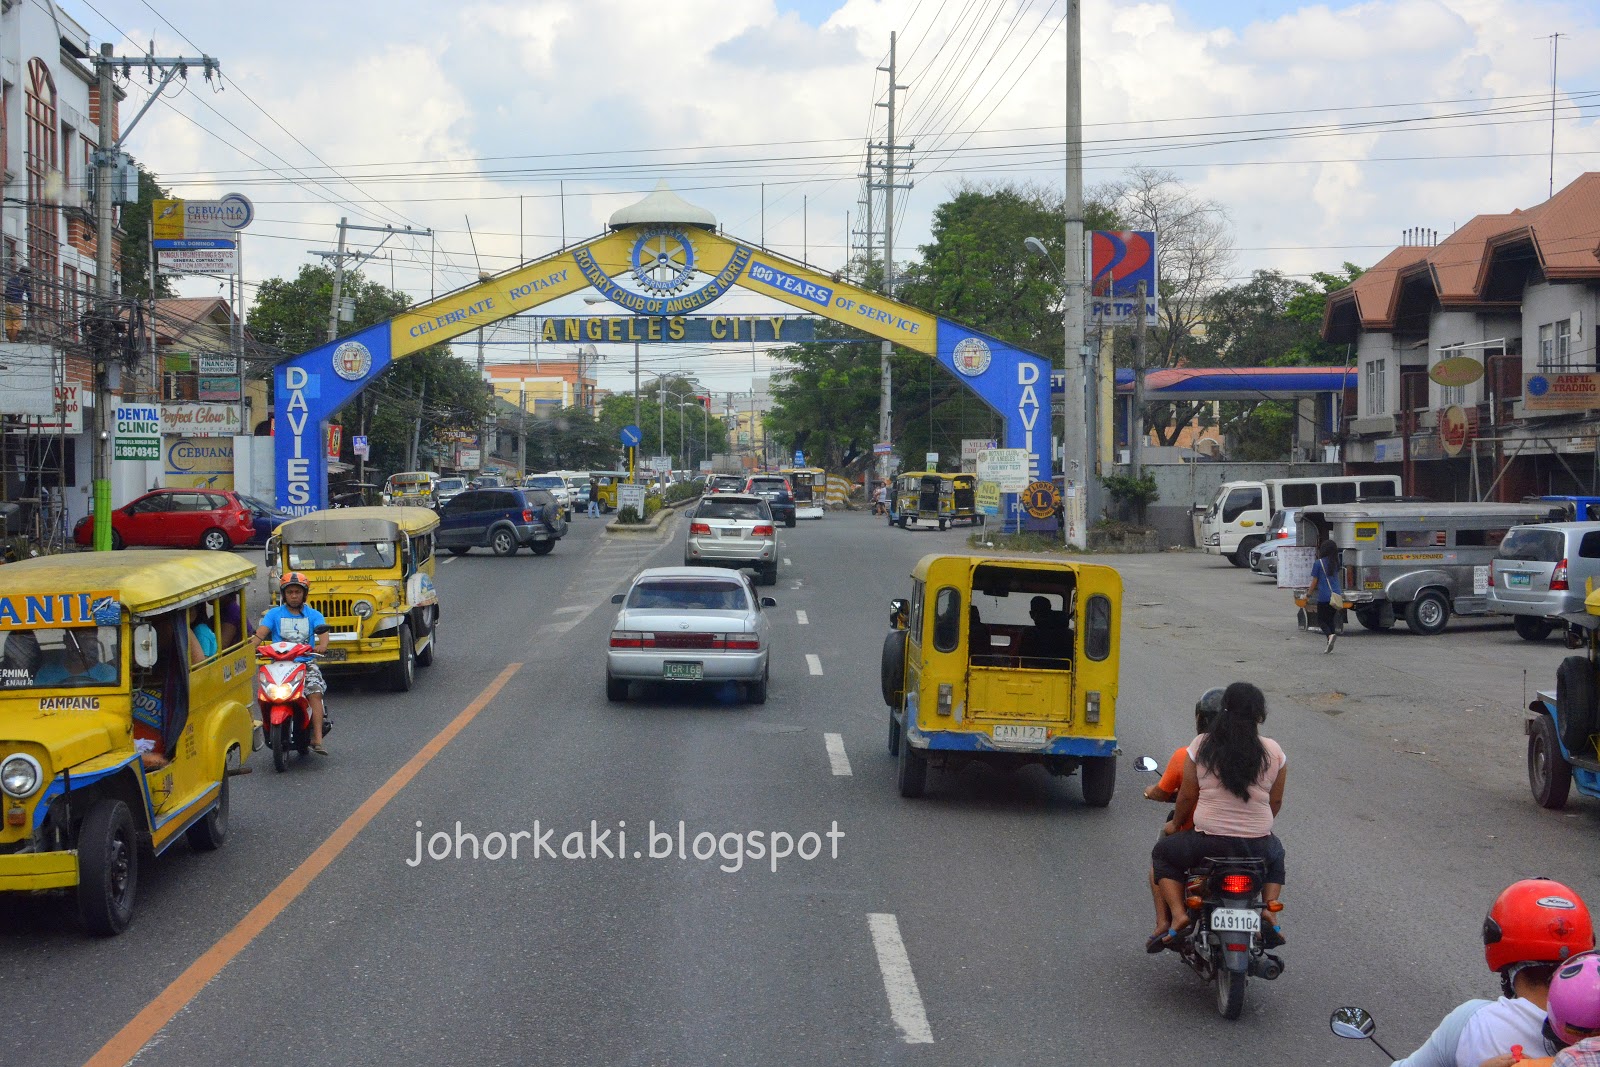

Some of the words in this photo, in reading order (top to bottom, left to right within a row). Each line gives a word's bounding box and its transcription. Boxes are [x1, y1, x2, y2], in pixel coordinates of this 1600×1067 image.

[187, 206, 244, 214] CEBUANA
[644, 229, 681, 240] ROTARY
[575, 249, 614, 293] ROTARY
[612, 289, 645, 311] CLUB
[646, 301, 663, 313] OF
[666, 284, 719, 313] ANGELES
[715, 248, 750, 291] NORTH
[635, 264, 692, 289] INTERNATIONAL
[751, 264, 773, 282] 100
[773, 272, 829, 302] YEARS
[409, 297, 496, 338] CELEBRATE
[509, 269, 569, 300] ROTARY
[835, 297, 855, 312] OF
[856, 304, 921, 335] SERVICE
[542, 316, 685, 341] ANGELES
[710, 316, 784, 340] CITY
[1555, 375, 1592, 383] ARFIL
[1552, 384, 1596, 392] TRADING
[117, 408, 159, 420] DENTAL
[161, 406, 193, 428] Perfect
[195, 406, 226, 424] Glow
[117, 422, 159, 434] CLINIC
[1018, 362, 1040, 483] DAVIE
[286, 366, 310, 505] DAVIES
[178, 447, 234, 458] CEBUANA
[982, 484, 996, 494] NO
[1031, 483, 1052, 491] LIONS
[1036, 492, 1047, 508] L
[39, 696, 100, 711] PAMPANG
[1213, 916, 1259, 930] CA91104
